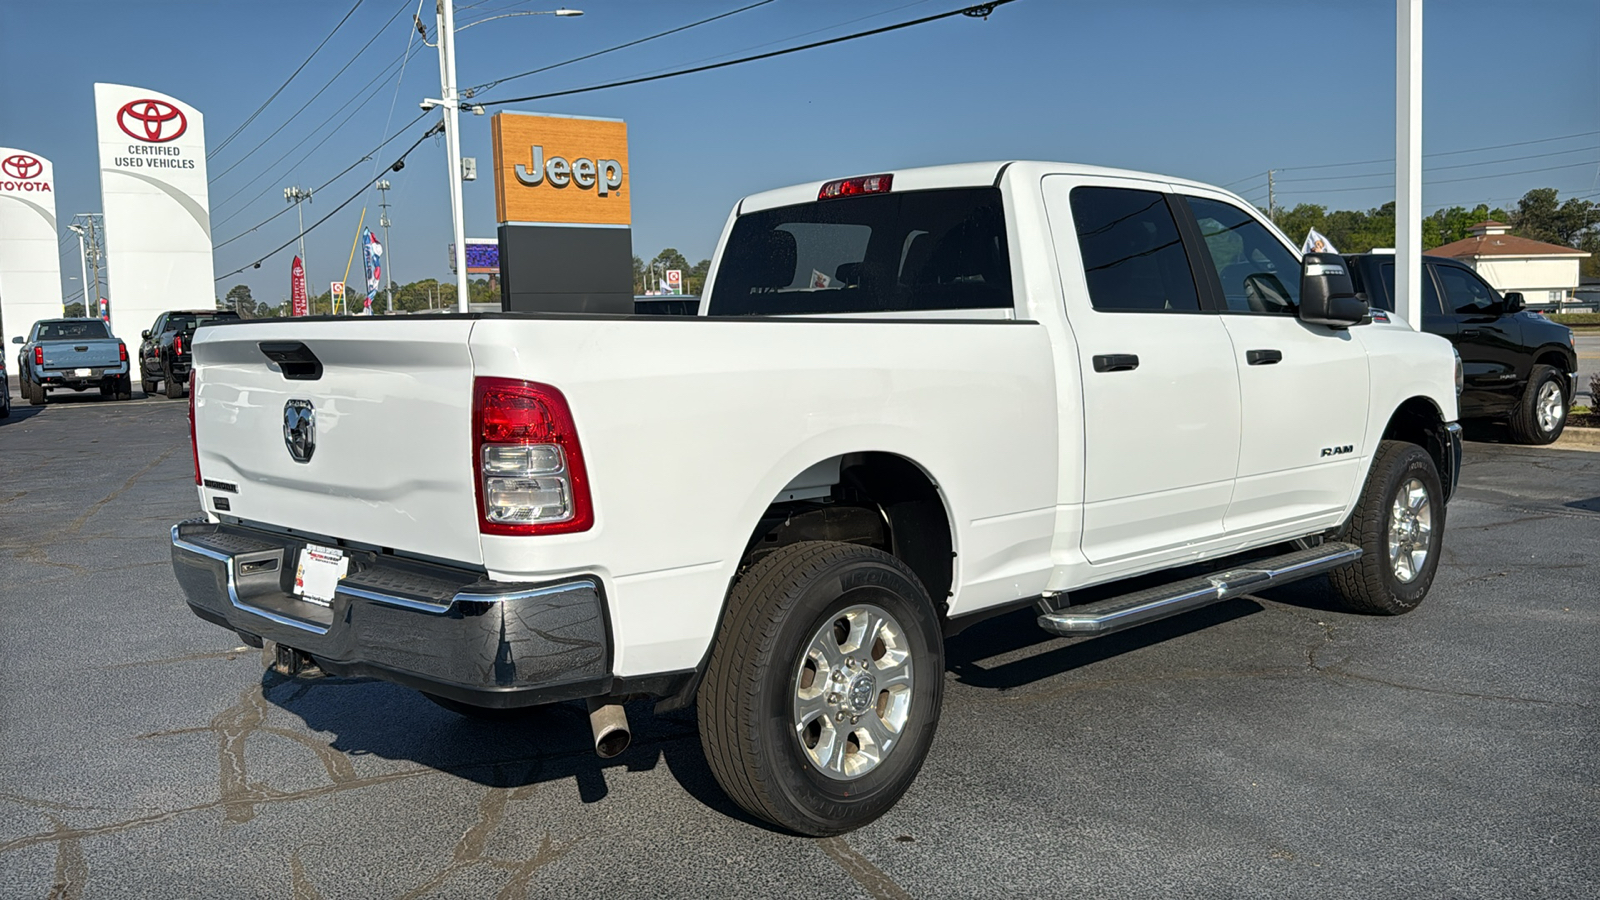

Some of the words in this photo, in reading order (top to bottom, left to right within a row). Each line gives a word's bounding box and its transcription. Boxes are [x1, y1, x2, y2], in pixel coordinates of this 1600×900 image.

[128, 145, 180, 156] CERTIFIED
[115, 157, 143, 167] USED
[146, 158, 195, 169] VEHICLES
[514, 145, 623, 197] Jeep
[0, 181, 52, 192] TOYOTA
[1320, 445, 1353, 457] RAM
